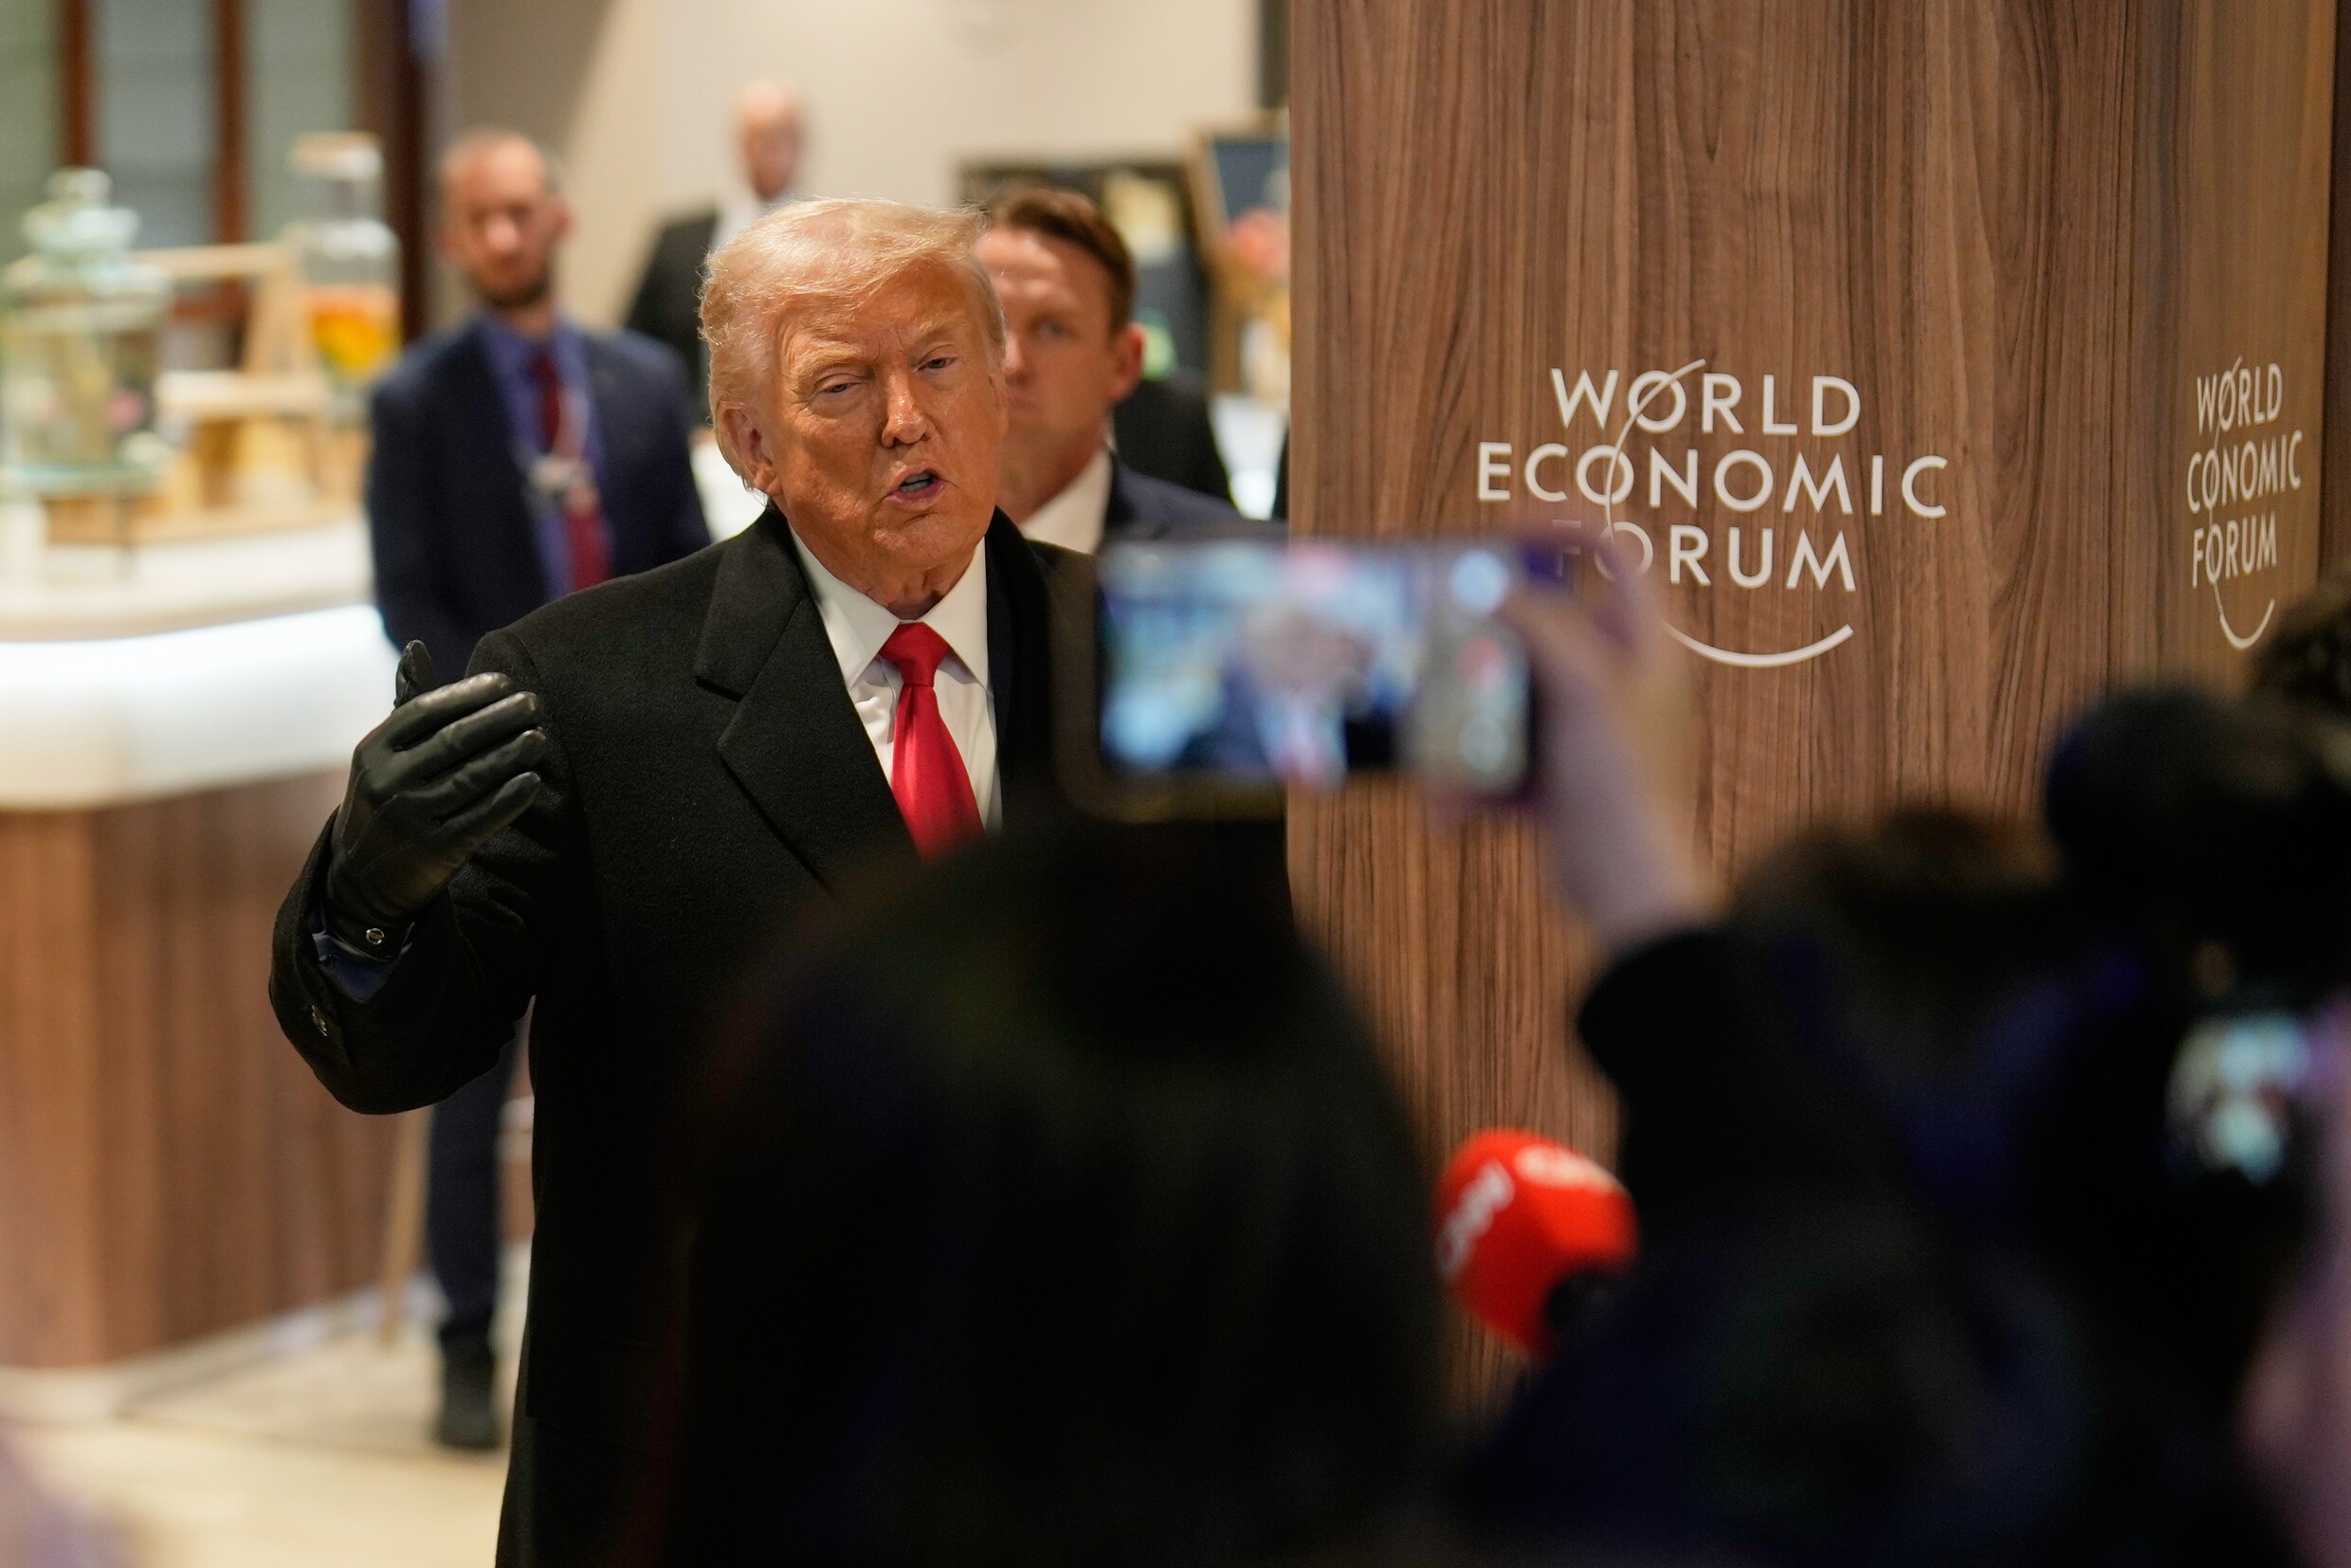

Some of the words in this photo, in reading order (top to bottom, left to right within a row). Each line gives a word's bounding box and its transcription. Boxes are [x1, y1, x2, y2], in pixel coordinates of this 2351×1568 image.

[1551, 368, 1861, 436] WORLD
[2196, 362, 2283, 437] WORLD
[1477, 441, 1949, 519] ECONOMIC
[2186, 429, 2304, 514] CONOMIC
[2192, 510, 2277, 590] FORUM
